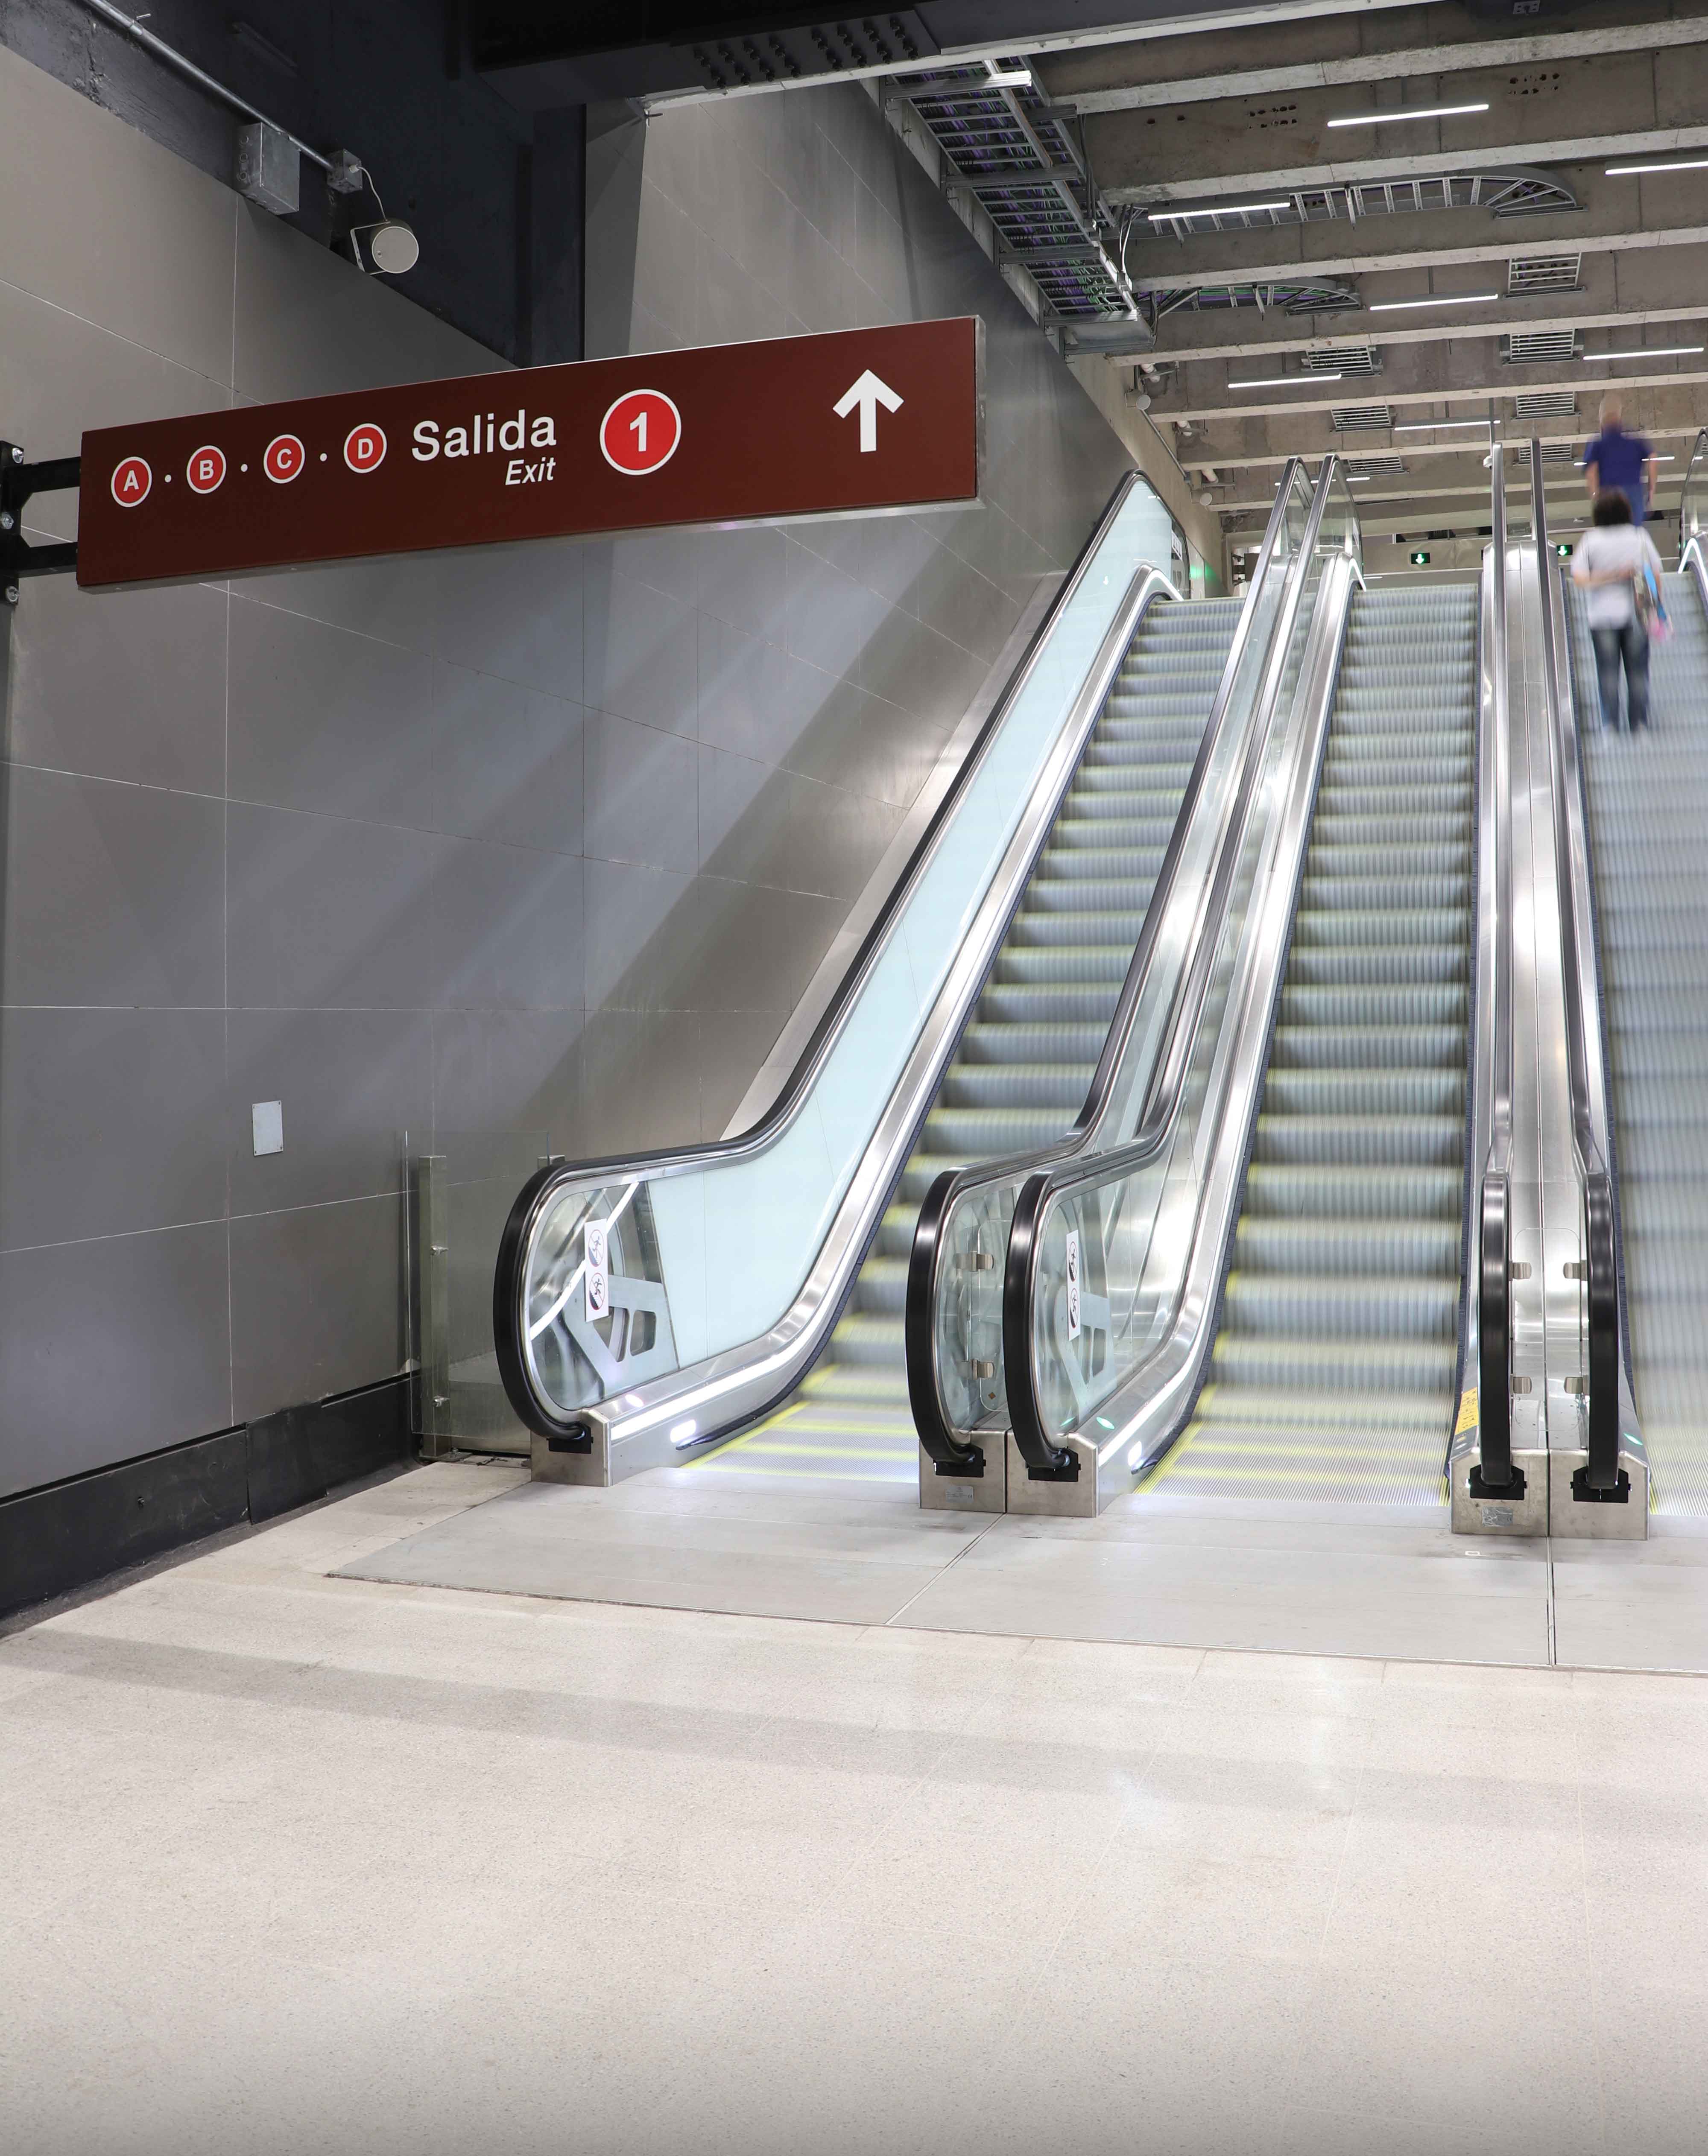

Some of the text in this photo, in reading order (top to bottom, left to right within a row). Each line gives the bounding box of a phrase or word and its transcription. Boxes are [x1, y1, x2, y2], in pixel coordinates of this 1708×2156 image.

[123, 409, 647, 492] A B C D Salida 1
[505, 457, 556, 486] Exit
